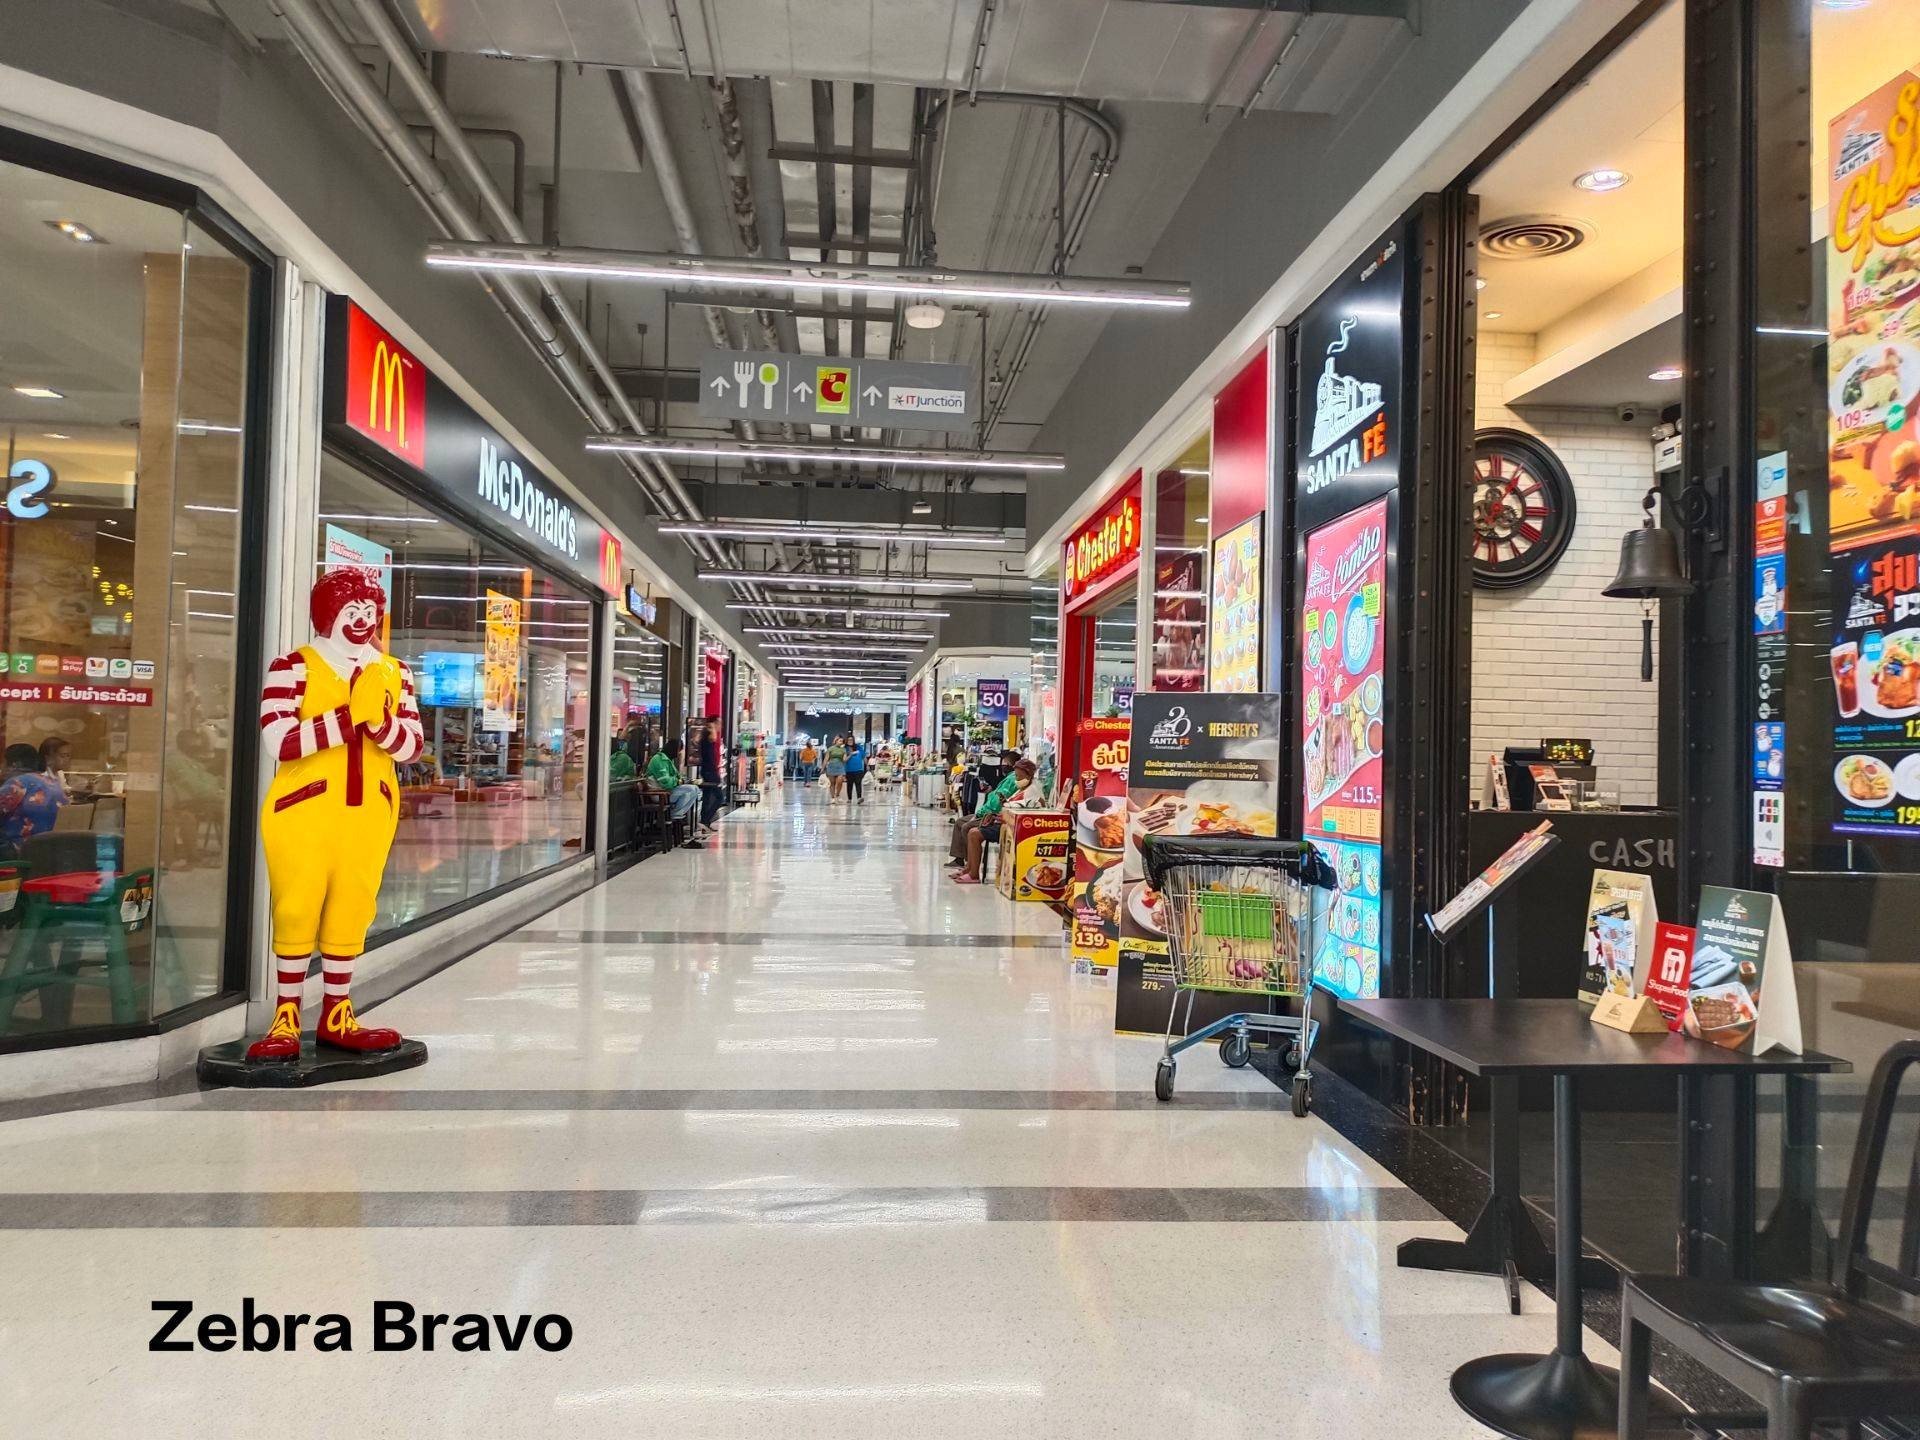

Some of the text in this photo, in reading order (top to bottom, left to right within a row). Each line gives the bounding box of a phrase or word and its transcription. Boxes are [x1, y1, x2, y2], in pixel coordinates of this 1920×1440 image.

[1306, 438, 1361, 494] SANTA
[478, 436, 578, 561] McDonald's
[1076, 498, 1134, 582] Chester's
[1845, 616, 1875, 629] SANTA
[136, 666, 153, 674] VISA
[982, 692, 1005, 707] 50
[1209, 722, 1259, 737] HERSHEY'S
[1589, 838, 1675, 869] CASH
[1142, 981, 1166, 990] 279.-
